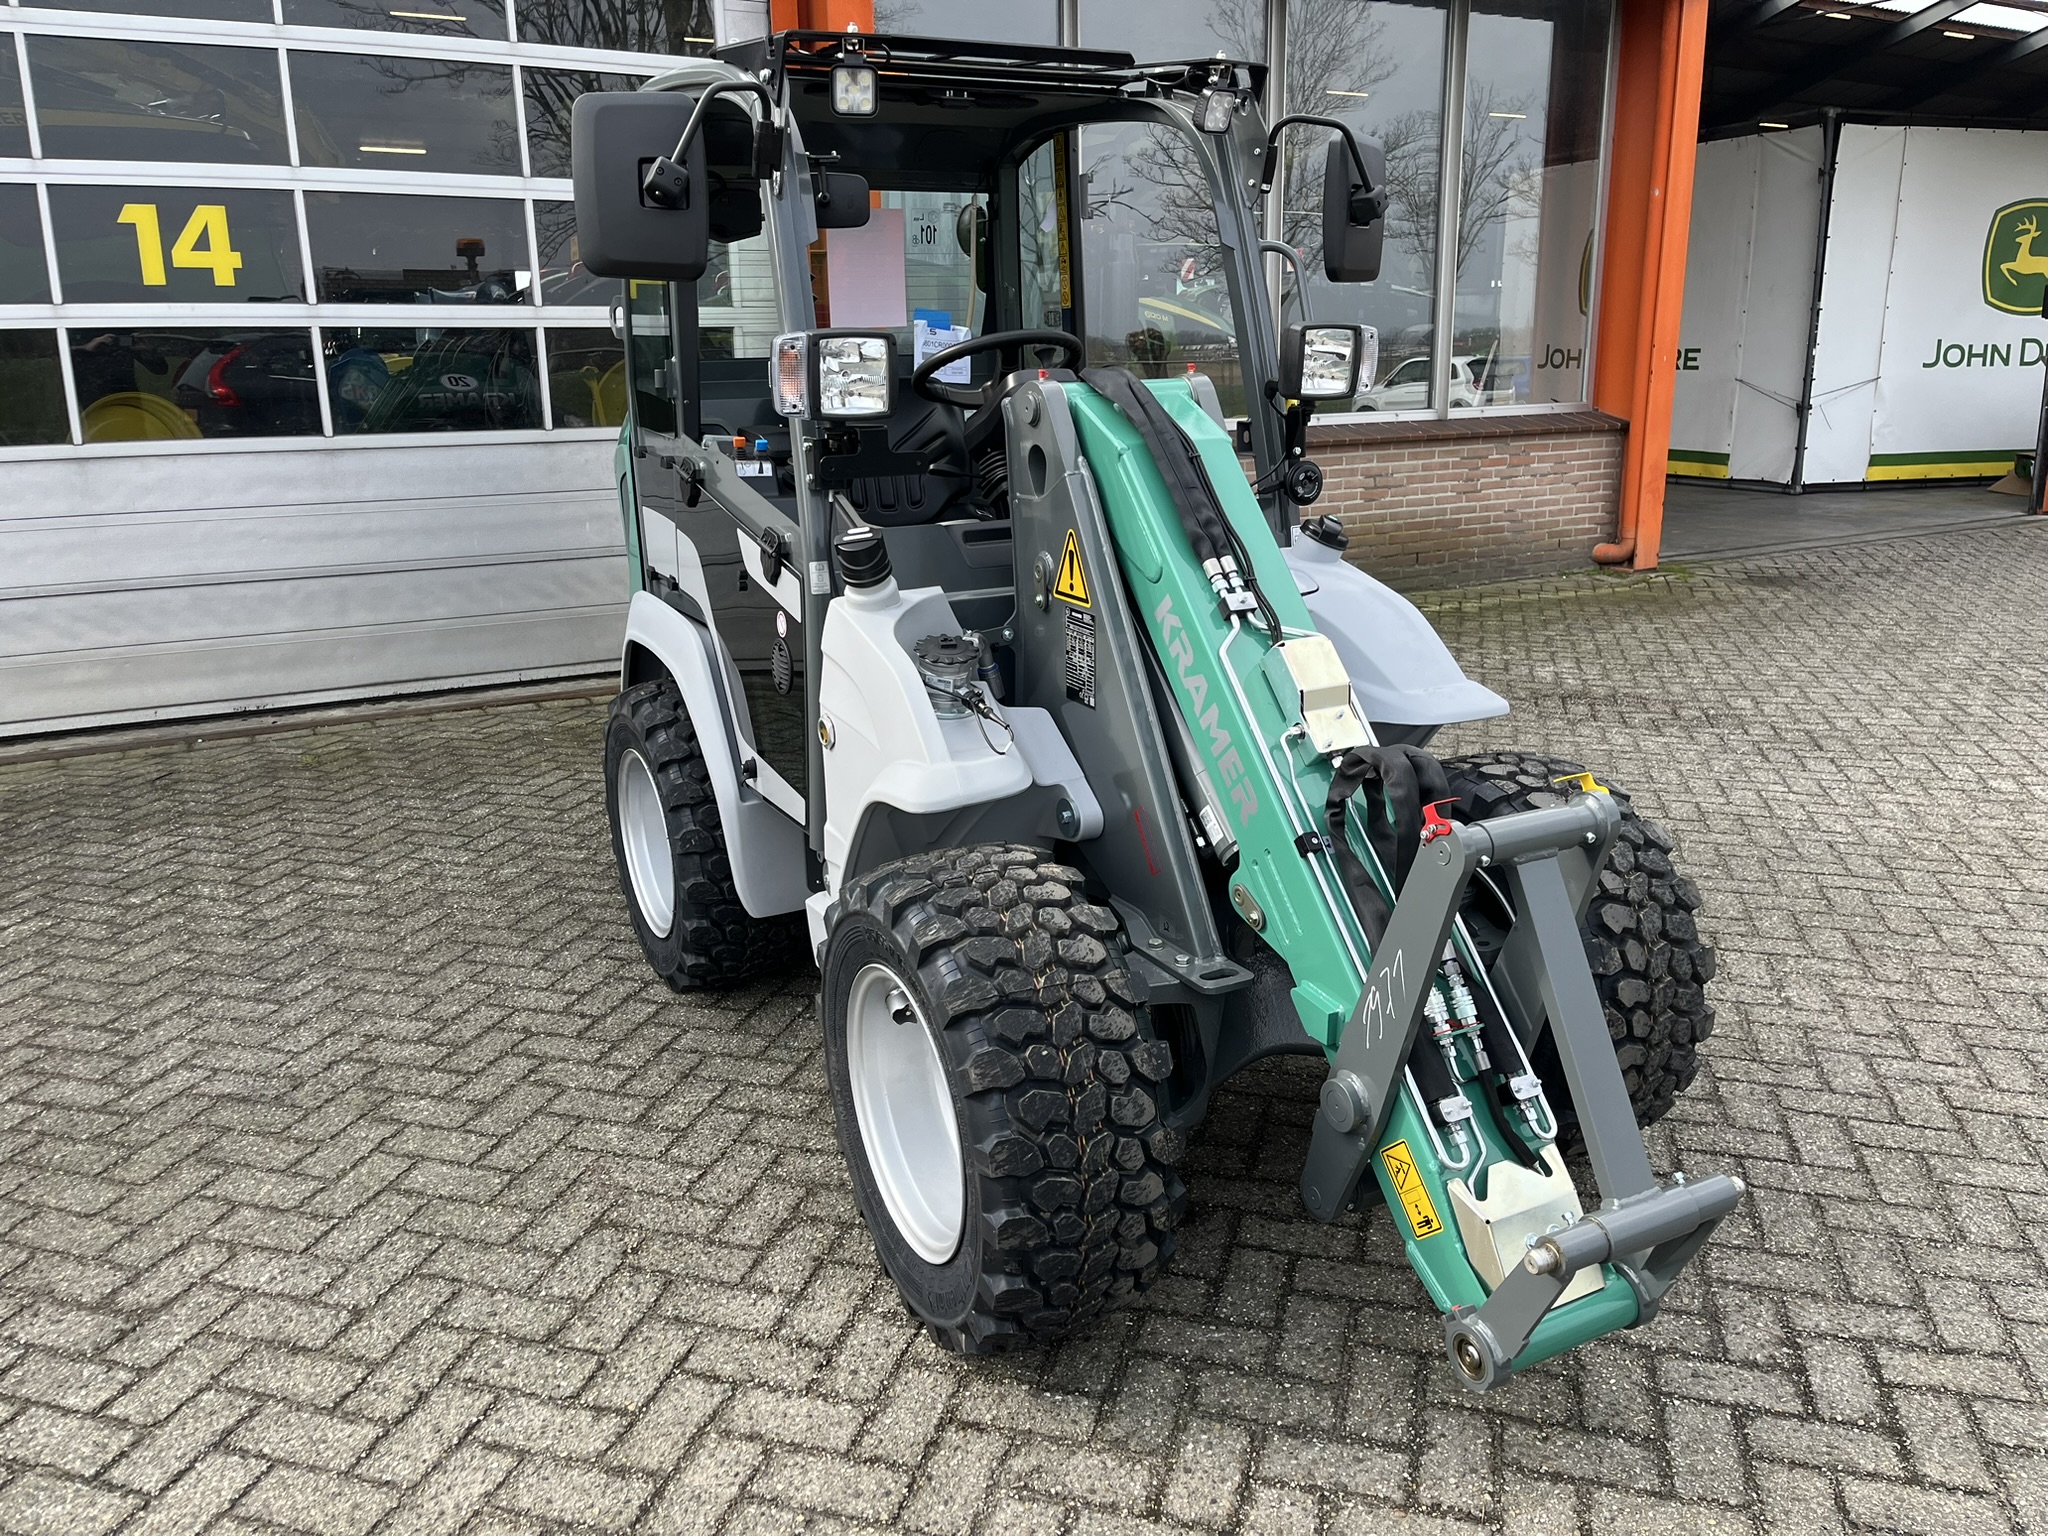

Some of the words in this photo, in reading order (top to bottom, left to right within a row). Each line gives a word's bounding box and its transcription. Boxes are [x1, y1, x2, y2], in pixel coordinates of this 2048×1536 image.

[117, 203, 242, 286] 14
[1537, 344, 1583, 369] JOH
[1922, 338, 2012, 368] JOHN
[2019, 337, 2048, 367] D
[1154, 593, 1259, 828] KRAMER
